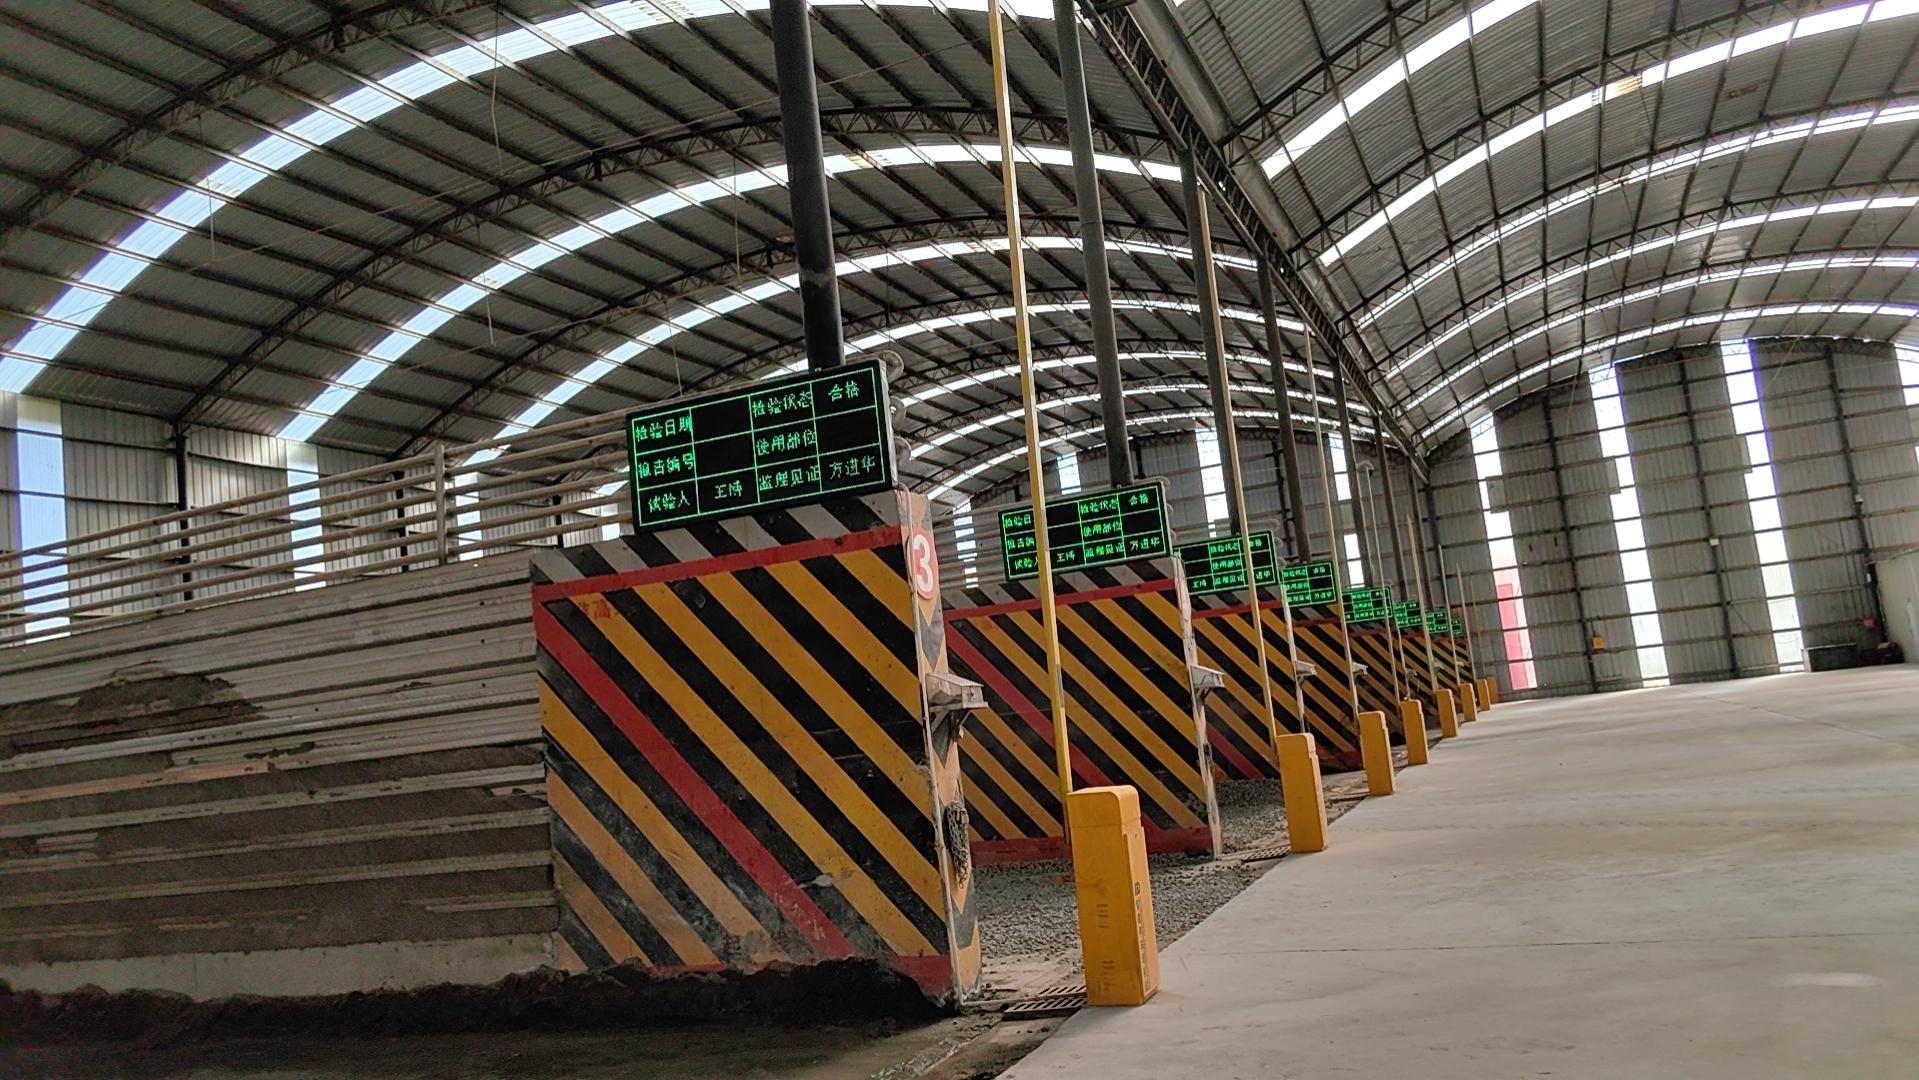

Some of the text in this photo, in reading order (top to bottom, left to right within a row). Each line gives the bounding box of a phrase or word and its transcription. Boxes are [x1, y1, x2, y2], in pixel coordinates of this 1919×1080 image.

[828, 380, 860, 402] 合格
[752, 390, 812, 418] 检验状态
[635, 415, 692, 442] 检验日期
[756, 429, 817, 455] 使用部位
[638, 453, 694, 478] 报告编号
[759, 465, 820, 491] 监理见证
[829, 455, 876, 480] 方进华
[648, 490, 690, 513] 试验人
[1004, 514, 1031, 528] 检验日
[1008, 536, 1035, 550] 报告编
[913, 534, 934, 594] 3
